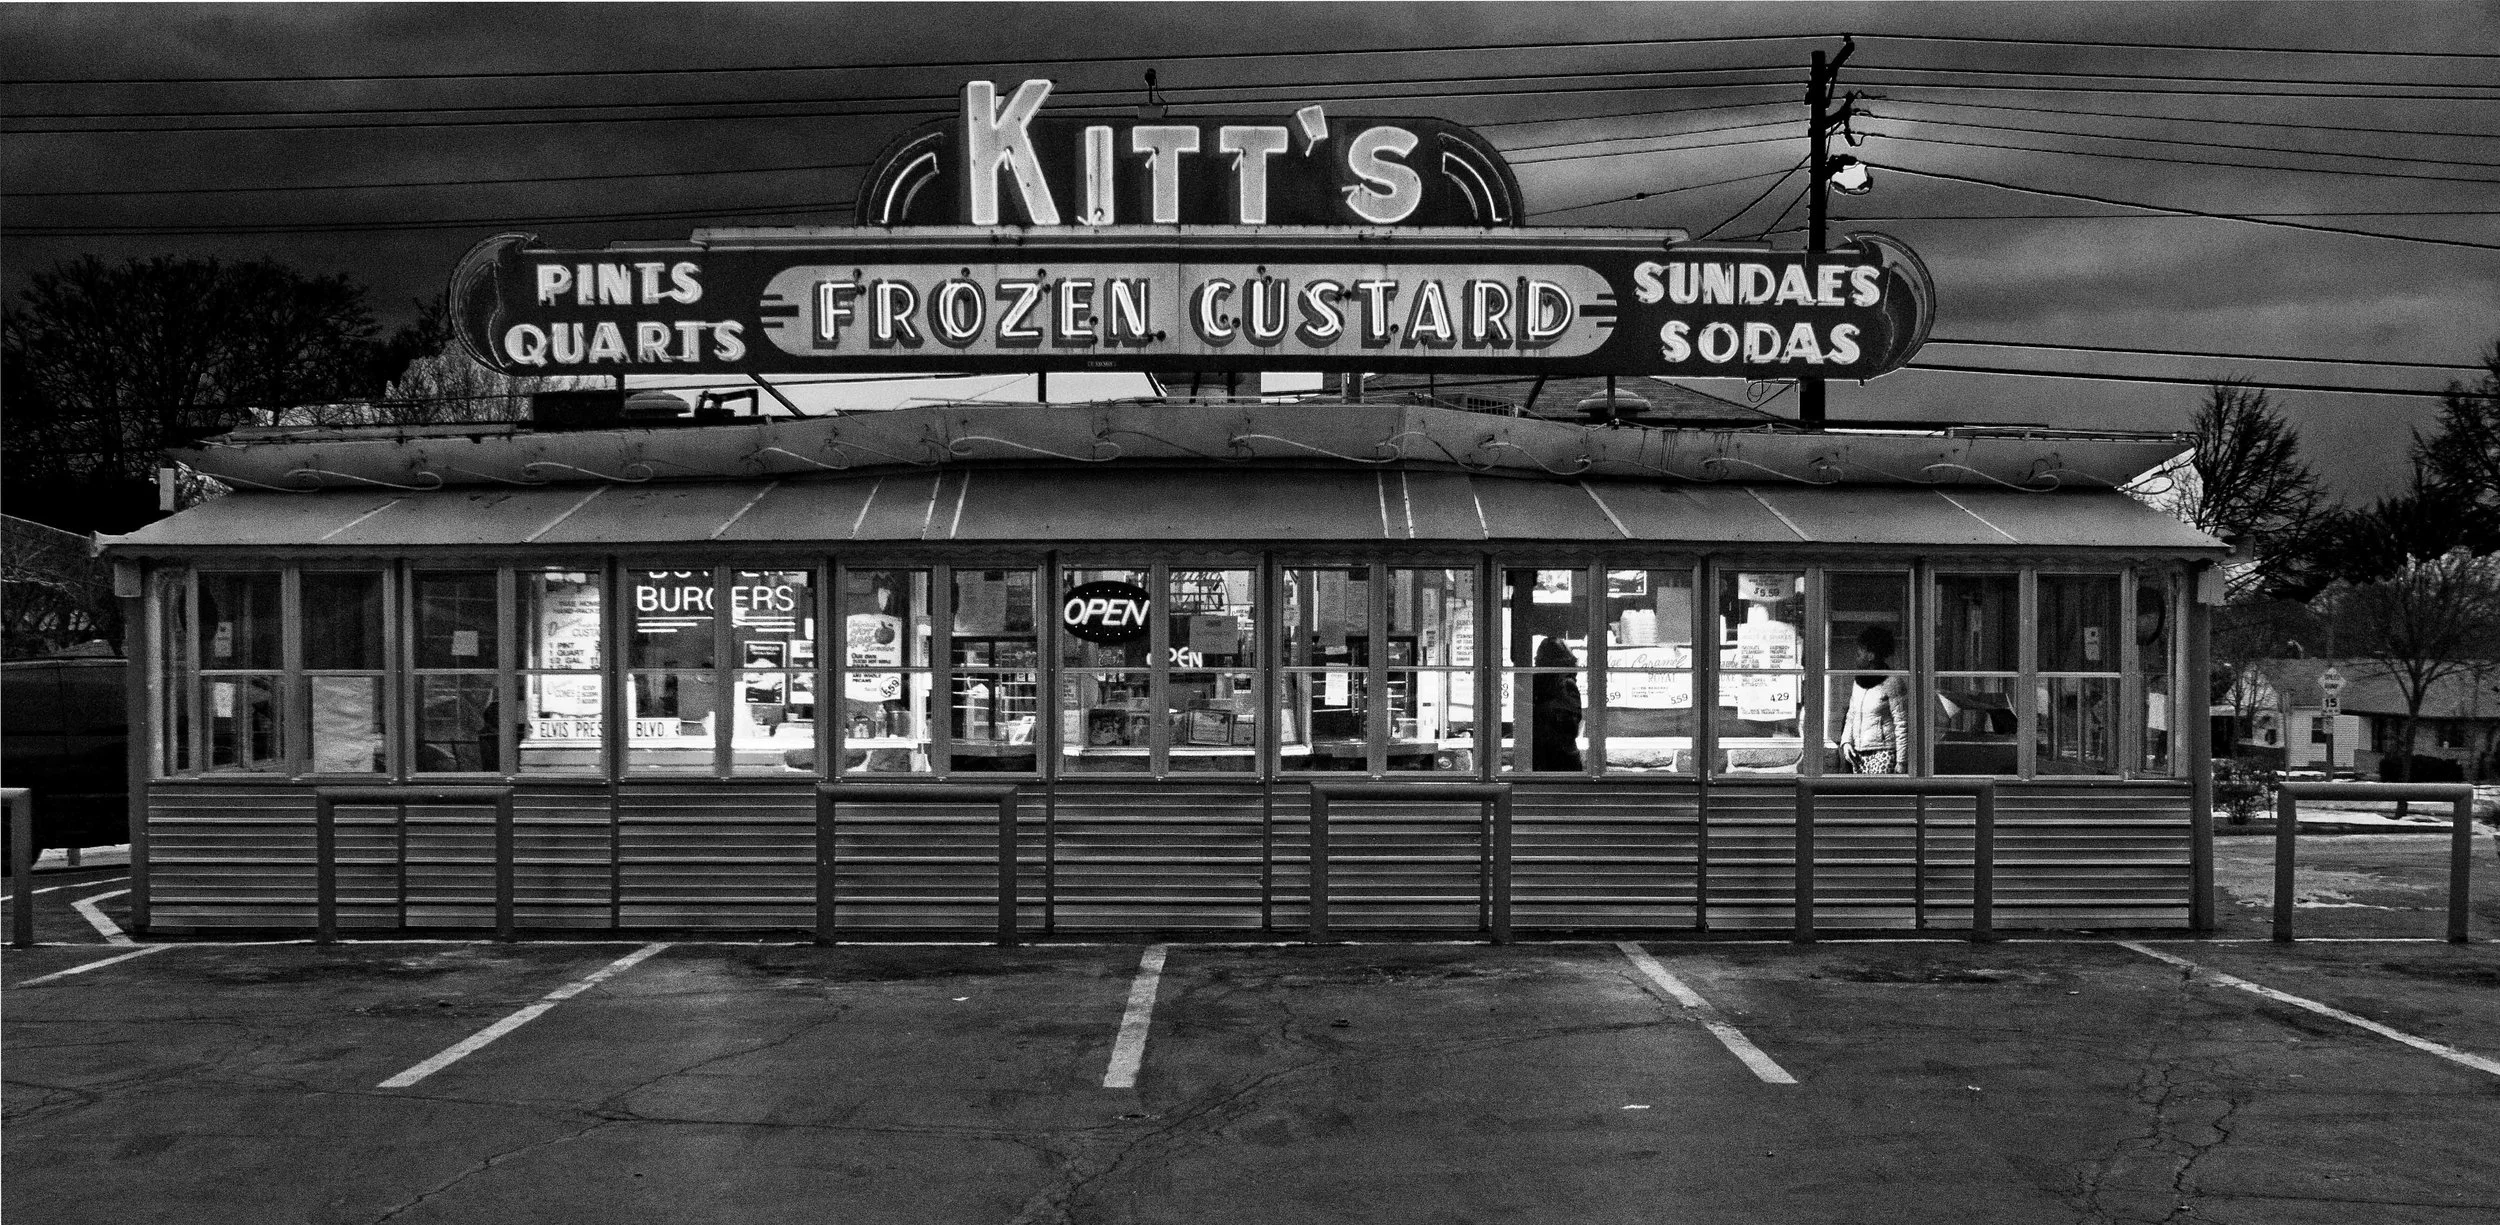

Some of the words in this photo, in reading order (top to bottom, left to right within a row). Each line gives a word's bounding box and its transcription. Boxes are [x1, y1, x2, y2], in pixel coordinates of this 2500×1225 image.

[966, 79, 1423, 226] KITT'S
[536, 261, 702, 306] PINTS
[1633, 261, 1881, 306] SUNDAES
[812, 277, 1152, 349] FROZEN
[1190, 277, 1573, 349] CUSTARD
[504, 320, 746, 367] QUARTS
[1660, 320, 1861, 364] SODAS
[572, 628, 600, 637] CUSTA
[1063, 598, 1150, 626] OPEN
[2325, 698, 2337, 707] 15
[540, 722, 569, 738] ELVIS
[576, 722, 604, 738] PRES
[636, 722, 665, 738] BLVD
